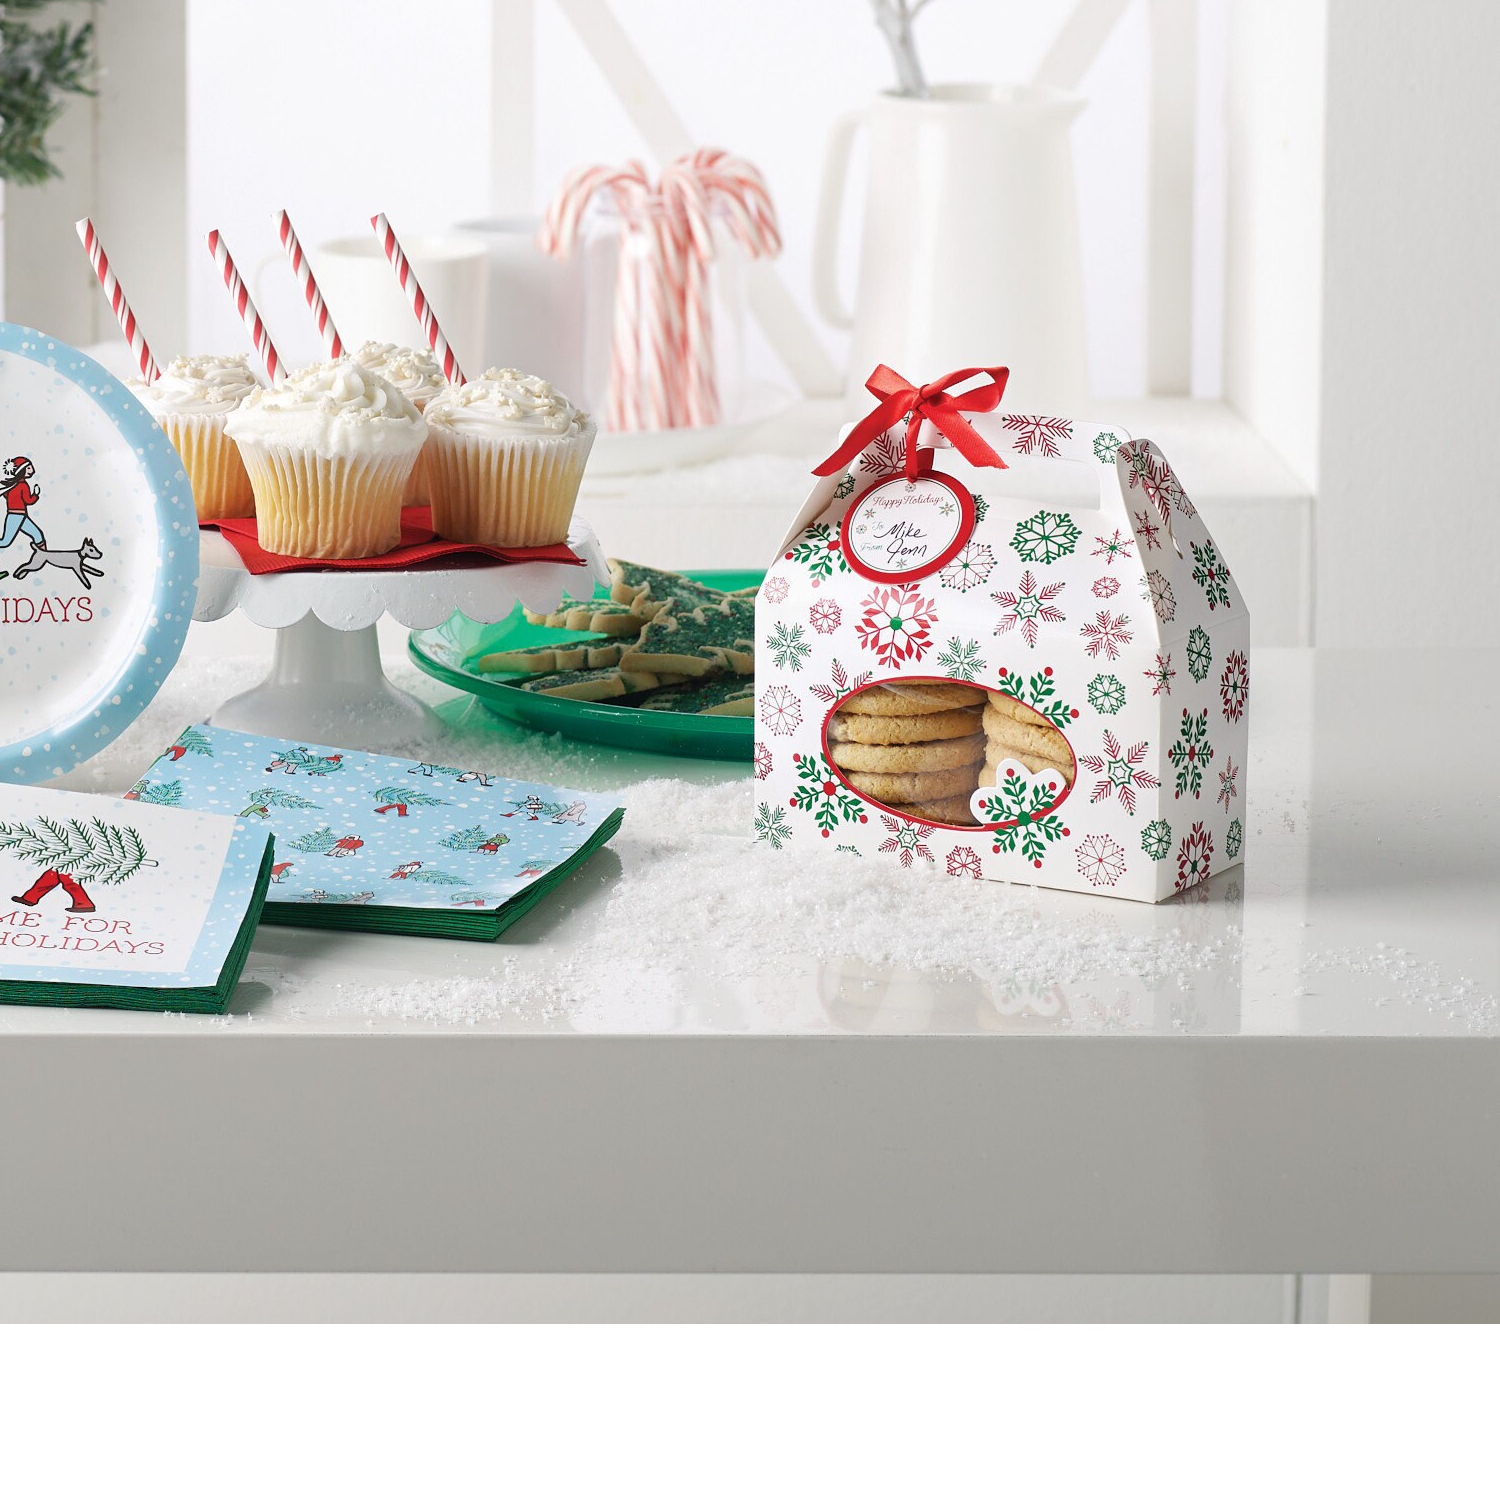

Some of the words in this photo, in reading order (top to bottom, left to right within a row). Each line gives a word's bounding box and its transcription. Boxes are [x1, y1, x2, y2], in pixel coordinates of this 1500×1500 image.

[872, 496, 902, 509] Happy
[903, 493, 944, 506] Holidays
[873, 521, 928, 538] Mike
[886, 538, 928, 564] Jenn
[61, 915, 133, 935] FOR
